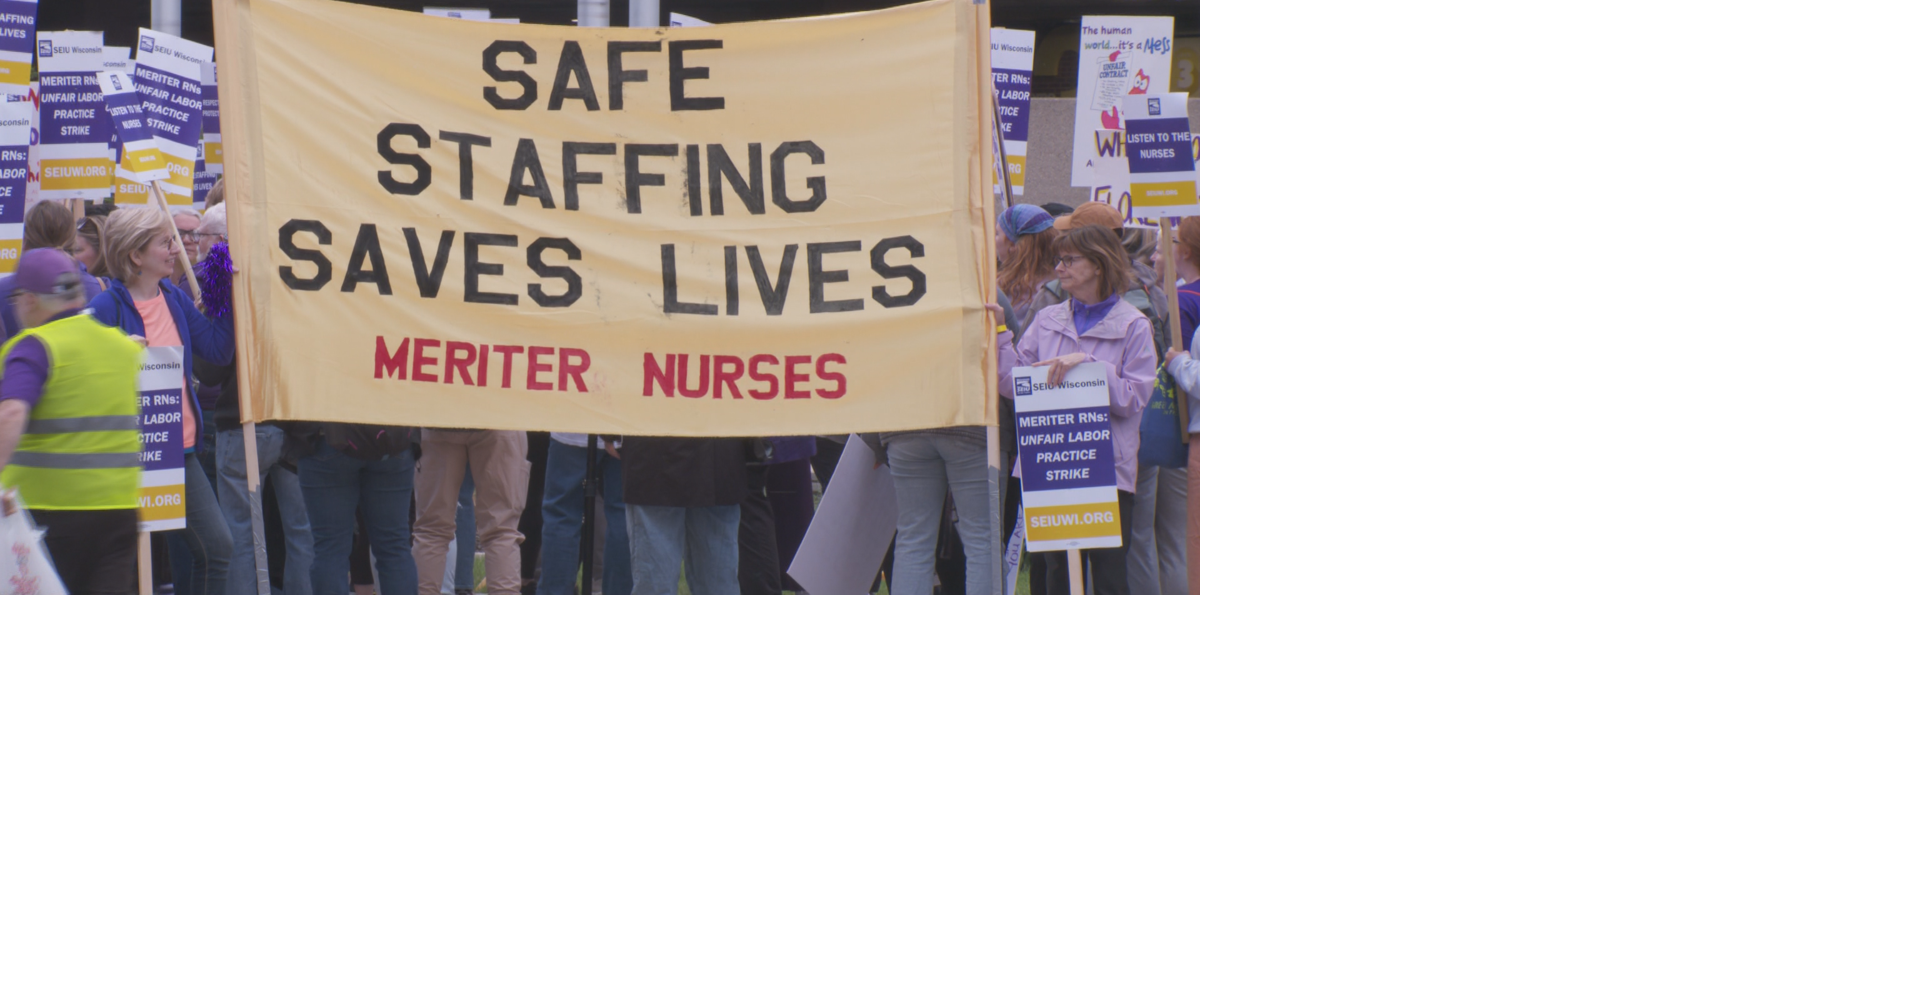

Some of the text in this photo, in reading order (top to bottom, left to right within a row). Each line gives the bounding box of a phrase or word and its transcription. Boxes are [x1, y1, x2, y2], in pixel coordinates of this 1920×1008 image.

[0, 13, 34, 25] AFFING
[1082, 26, 1132, 35] The human
[53, 45, 102, 54] SEIU Wisconsin
[154, 45, 172, 55] SEIU
[991, 43, 1033, 53] IU Wisconsin
[135, 67, 180, 88] MERITER
[482, 39, 726, 112] SAFE
[1011, 74, 1031, 85] RNs:
[1177, 59, 1194, 89] 3
[41, 76, 82, 86] MERITER
[41, 92, 76, 103] UNFAIR
[77, 93, 104, 102] LABOR
[134, 83, 203, 110] UNFAIR LABOR
[1001, 89, 1031, 101] LABOR
[53, 109, 95, 119] PRACTICE
[110, 106, 128, 116] LISTEN
[127, 105, 134, 114] TO
[134, 104, 143, 113] THE
[142, 101, 190, 122] PRACTICE
[999, 106, 1019, 116] TICE
[0, 117, 29, 127] sconsin
[122, 119, 142, 129] NURSES
[146, 118, 181, 135] STRIKE
[60, 125, 91, 136] STRIKE
[1127, 132, 1191, 144] LISTEN TO THE
[1, 150, 26, 161] RNs:
[1140, 148, 1176, 159] NURSES
[44, 165, 107, 178] SEIUWI.ORG
[376, 121, 828, 217] STAFFING
[278, 218, 928, 317] SAVES LIVES
[373, 336, 848, 400] MERITER NURSES
[1032, 378, 1106, 391] SEIU Wisconsin
[154, 394, 180, 406] RNs:
[143, 412, 181, 425] LABOR
[1019, 411, 1108, 428] MERITER RNs:
[137, 431, 169, 444] CTICE
[1020, 429, 1110, 446] UNFAIR LABOR
[137, 450, 162, 462] RIKE
[1036, 448, 1097, 463] PRACTICE
[1045, 467, 1090, 481] STRIKE
[136, 493, 181, 508] WI.ORG
[1030, 511, 1114, 528] SEIUWI.ORG
